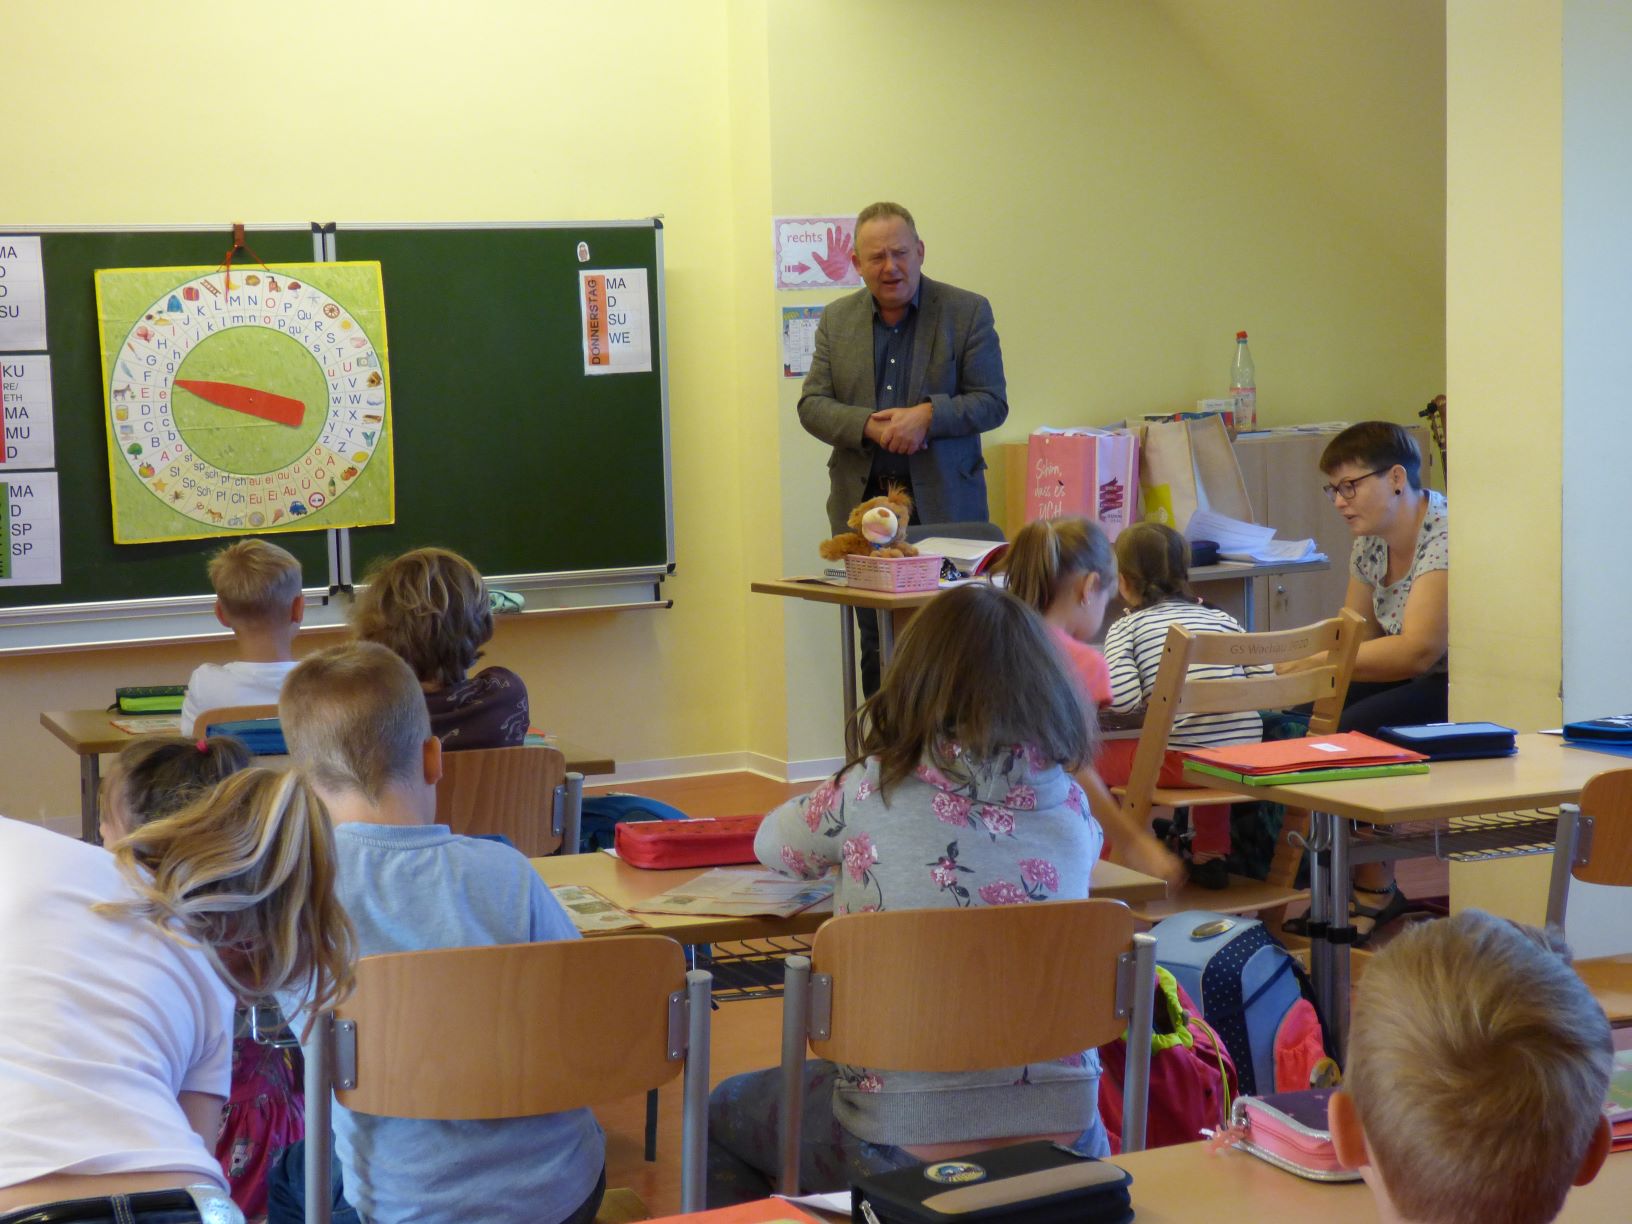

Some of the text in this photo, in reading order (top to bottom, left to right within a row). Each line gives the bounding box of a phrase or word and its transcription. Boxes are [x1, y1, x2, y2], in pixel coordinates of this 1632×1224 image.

[787, 231, 823, 244] rechts
[606, 278, 626, 289] MA
[215, 300, 222, 310] L
[230, 296, 240, 306] M
[248, 296, 257, 305] N
[266, 298, 275, 308] O
[608, 296, 616, 307] D
[0, 305, 19, 318] SU
[197, 306, 205, 316] K
[284, 303, 292, 312] P
[183, 315, 189, 325] J
[233, 315, 243, 323] m
[264, 316, 271, 324] o
[297, 310, 311, 321] Qu
[608, 314, 626, 325] SU
[208, 322, 214, 331] k
[278, 319, 285, 329] p
[315, 321, 322, 331] R
[588, 279, 601, 364] DONNERSTAG
[289, 327, 301, 336] qu
[327, 333, 335, 343] S
[609, 332, 630, 344] WE
[157, 339, 167, 349] H
[173, 350, 180, 360] h
[336, 348, 344, 357] T
[147, 355, 156, 366] G
[3, 365, 24, 377] KU
[166, 363, 173, 373] g
[343, 362, 351, 372] U
[144, 371, 151, 382] F
[348, 378, 356, 388] V
[141, 388, 150, 398] E
[160, 390, 167, 399] e
[349, 394, 361, 404] W
[5, 407, 28, 419] MA
[141, 404, 150, 415] D
[160, 403, 167, 414] d
[349, 410, 357, 420] X
[144, 422, 153, 432] C
[329, 422, 335, 432] y
[6, 427, 30, 439] MU
[168, 431, 175, 440] b
[346, 428, 353, 438] Y
[152, 437, 160, 447] B
[338, 442, 346, 452] Z
[7, 446, 17, 458] D
[175, 444, 182, 452] a
[161, 451, 169, 461] A
[194, 463, 205, 472] sp
[182, 477, 195, 489] Sp
[235, 477, 246, 486] ch
[10, 485, 34, 497] MA
[284, 486, 296, 496] Au
[231, 493, 245, 504] Ch
[250, 494, 262, 504] Eu
[11, 505, 21, 517] D
[12, 524, 32, 536] SP
[12, 543, 32, 555] SP
[1230, 645, 1244, 654] GS
